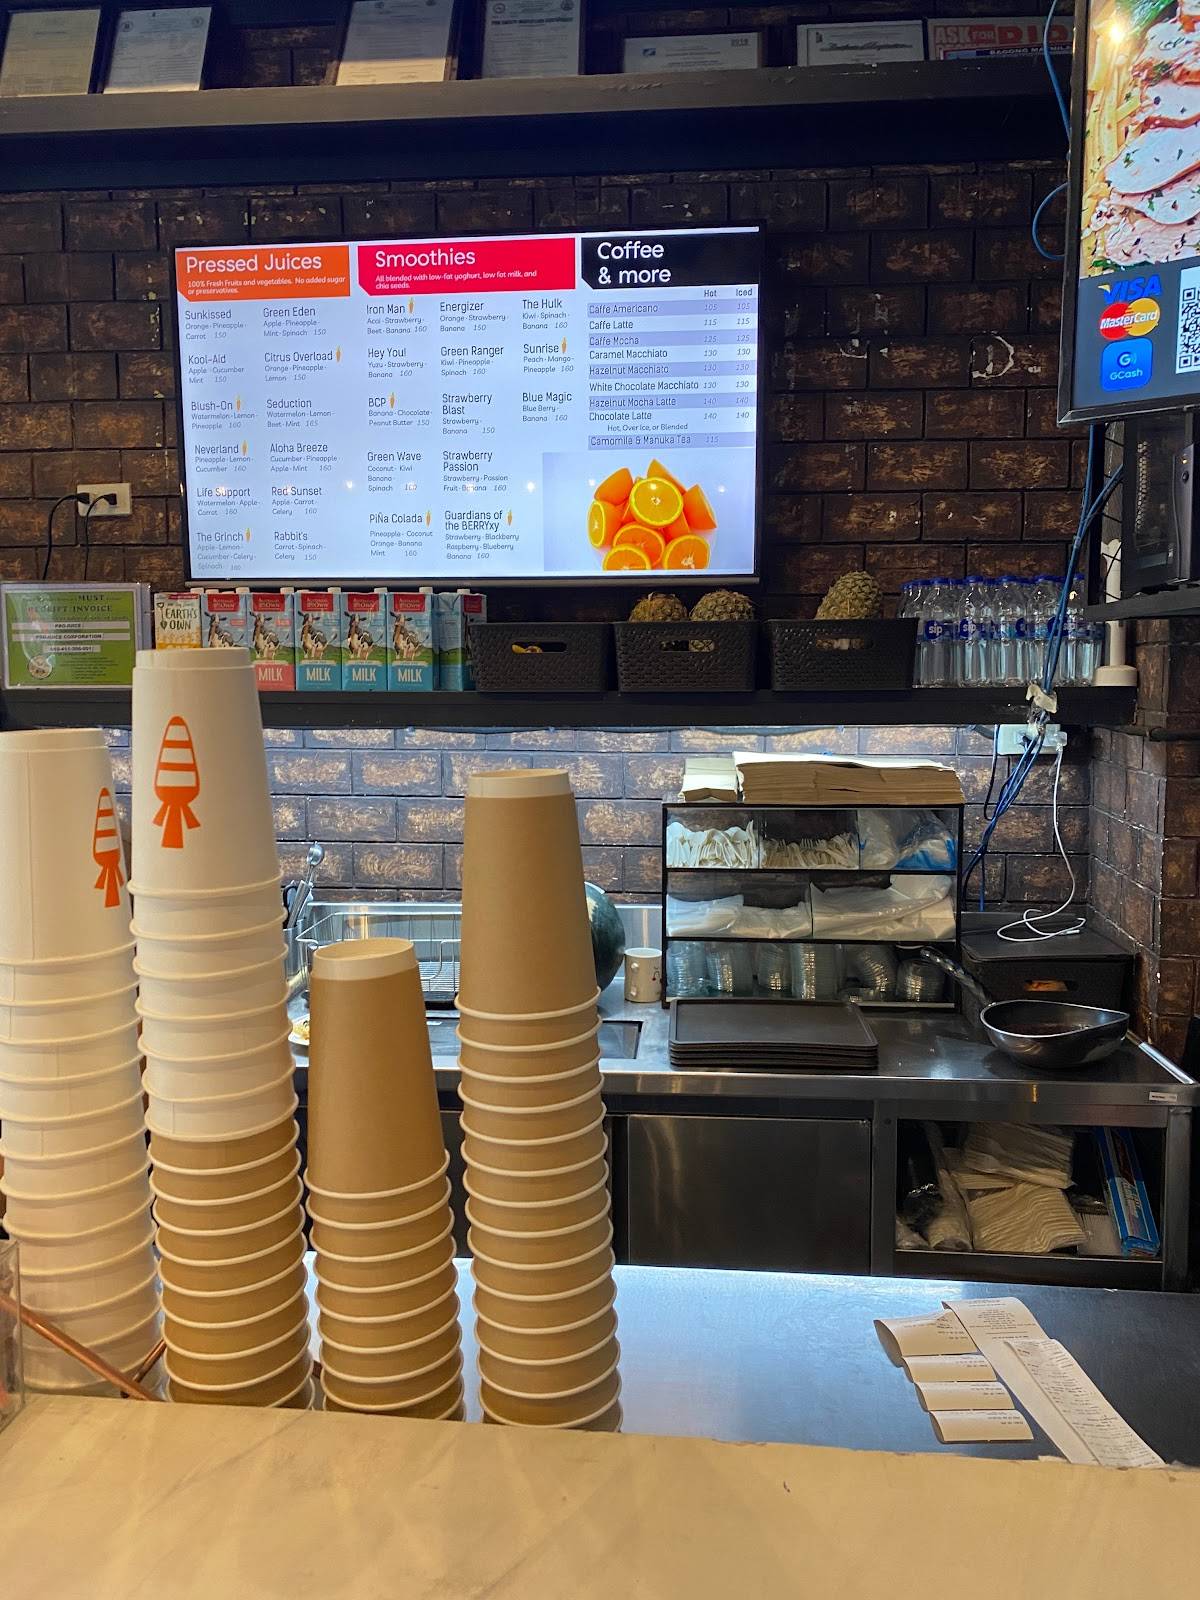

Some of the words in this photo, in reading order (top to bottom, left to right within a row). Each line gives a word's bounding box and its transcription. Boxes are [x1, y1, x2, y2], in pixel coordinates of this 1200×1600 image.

[935, 25, 971, 43] ASK
[597, 241, 664, 260] Coffee
[186, 254, 258, 273] Pressed
[264, 253, 322, 271] Juices
[375, 248, 476, 267] Smoothies
[429, 273, 453, 281] low-fat
[598, 267, 611, 284] &
[619, 268, 671, 283] more
[188, 280, 204, 288] 100%
[305, 276, 325, 284] added
[327, 276, 345, 284] sugar
[704, 289, 717, 297] Hot
[736, 288, 752, 296] Iced
[1098, 274, 1162, 303] VISA
[367, 305, 385, 314] Iron
[387, 304, 405, 314] Man
[440, 302, 484, 313] Energizer
[523, 299, 538, 309] The
[542, 298, 562, 309] Hulk
[589, 305, 610, 314] Caffe
[613, 304, 658, 313] Americano
[185, 309, 231, 320] Sunkissed
[263, 308, 289, 318] Green
[293, 307, 315, 317] Eden
[440, 314, 464, 323] Orange
[469, 313, 506, 322] Strawberry
[589, 321, 611, 330] Caffe
[613, 320, 633, 329] Latte
[1100, 310, 1158, 329] MasterCard
[282, 329, 308, 337] Spinach
[589, 336, 610, 345] Caffe
[613, 336, 639, 345] Mocha
[368, 348, 384, 360] Hey
[387, 348, 406, 357] You!
[441, 347, 468, 356] Green
[471, 346, 504, 357] Ranger
[523, 344, 559, 354] Sunrise
[589, 350, 624, 360] Caramel
[626, 349, 668, 358] Macchiato
[188, 354, 226, 364] Kool-Aid
[264, 352, 290, 362] Citrus
[293, 350, 333, 361] Overload
[589, 366, 625, 375] Hazelnut
[628, 365, 669, 374] Macchiato
[1110, 368, 1143, 380] GCash
[589, 382, 612, 392] White
[615, 382, 655, 391] Chocolate
[658, 380, 699, 390] Macchiato
[266, 398, 312, 408] Seduction
[369, 398, 386, 407] BCP
[442, 393, 492, 405] Strawberry
[523, 392, 543, 402] Blue
[546, 392, 572, 403] Magic
[589, 398, 625, 407] Hazelnut
[628, 398, 653, 407] Mocha
[656, 397, 676, 406] Latte
[191, 400, 233, 411] Blush-On
[442, 405, 465, 415] Blast
[589, 412, 630, 421] Chocolate
[632, 411, 651, 420] Latte
[591, 436, 633, 446] Camomile
[644, 435, 674, 444] Manuka
[677, 435, 690, 443] Tea
[195, 444, 239, 455] Neverland
[270, 443, 294, 453] Aloha
[297, 443, 328, 452] Breeze
[367, 452, 394, 461] Green
[397, 451, 421, 461] Wave
[443, 450, 492, 462] Strawberry
[443, 461, 479, 472] Passion
[197, 487, 213, 497] Life
[215, 488, 251, 499] Support
[271, 487, 288, 496] Red
[291, 486, 322, 495] Sunset
[391, 513, 423, 523] Colada
[445, 510, 491, 521] Guardians
[494, 510, 503, 519] of
[445, 521, 459, 531] the
[461, 521, 499, 533] BERRYxy
[197, 532, 212, 542] The
[215, 531, 243, 542] Grinch
[274, 531, 308, 541] Rabbit's
[445, 533, 481, 541] Strawberry
[485, 533, 519, 541] Blackberry
[447, 543, 479, 551] Raspberry
[483, 543, 513, 551] Blueberry
[72, 604, 112, 613] INVOICE
[165, 608, 198, 620] EARTH'S
[169, 619, 191, 630] OWN
[928, 623, 942, 635] sip
[258, 667, 283, 681] MILK
[306, 667, 331, 681] MILK
[352, 667, 376, 682] MILK
[398, 668, 422, 683] MILK
